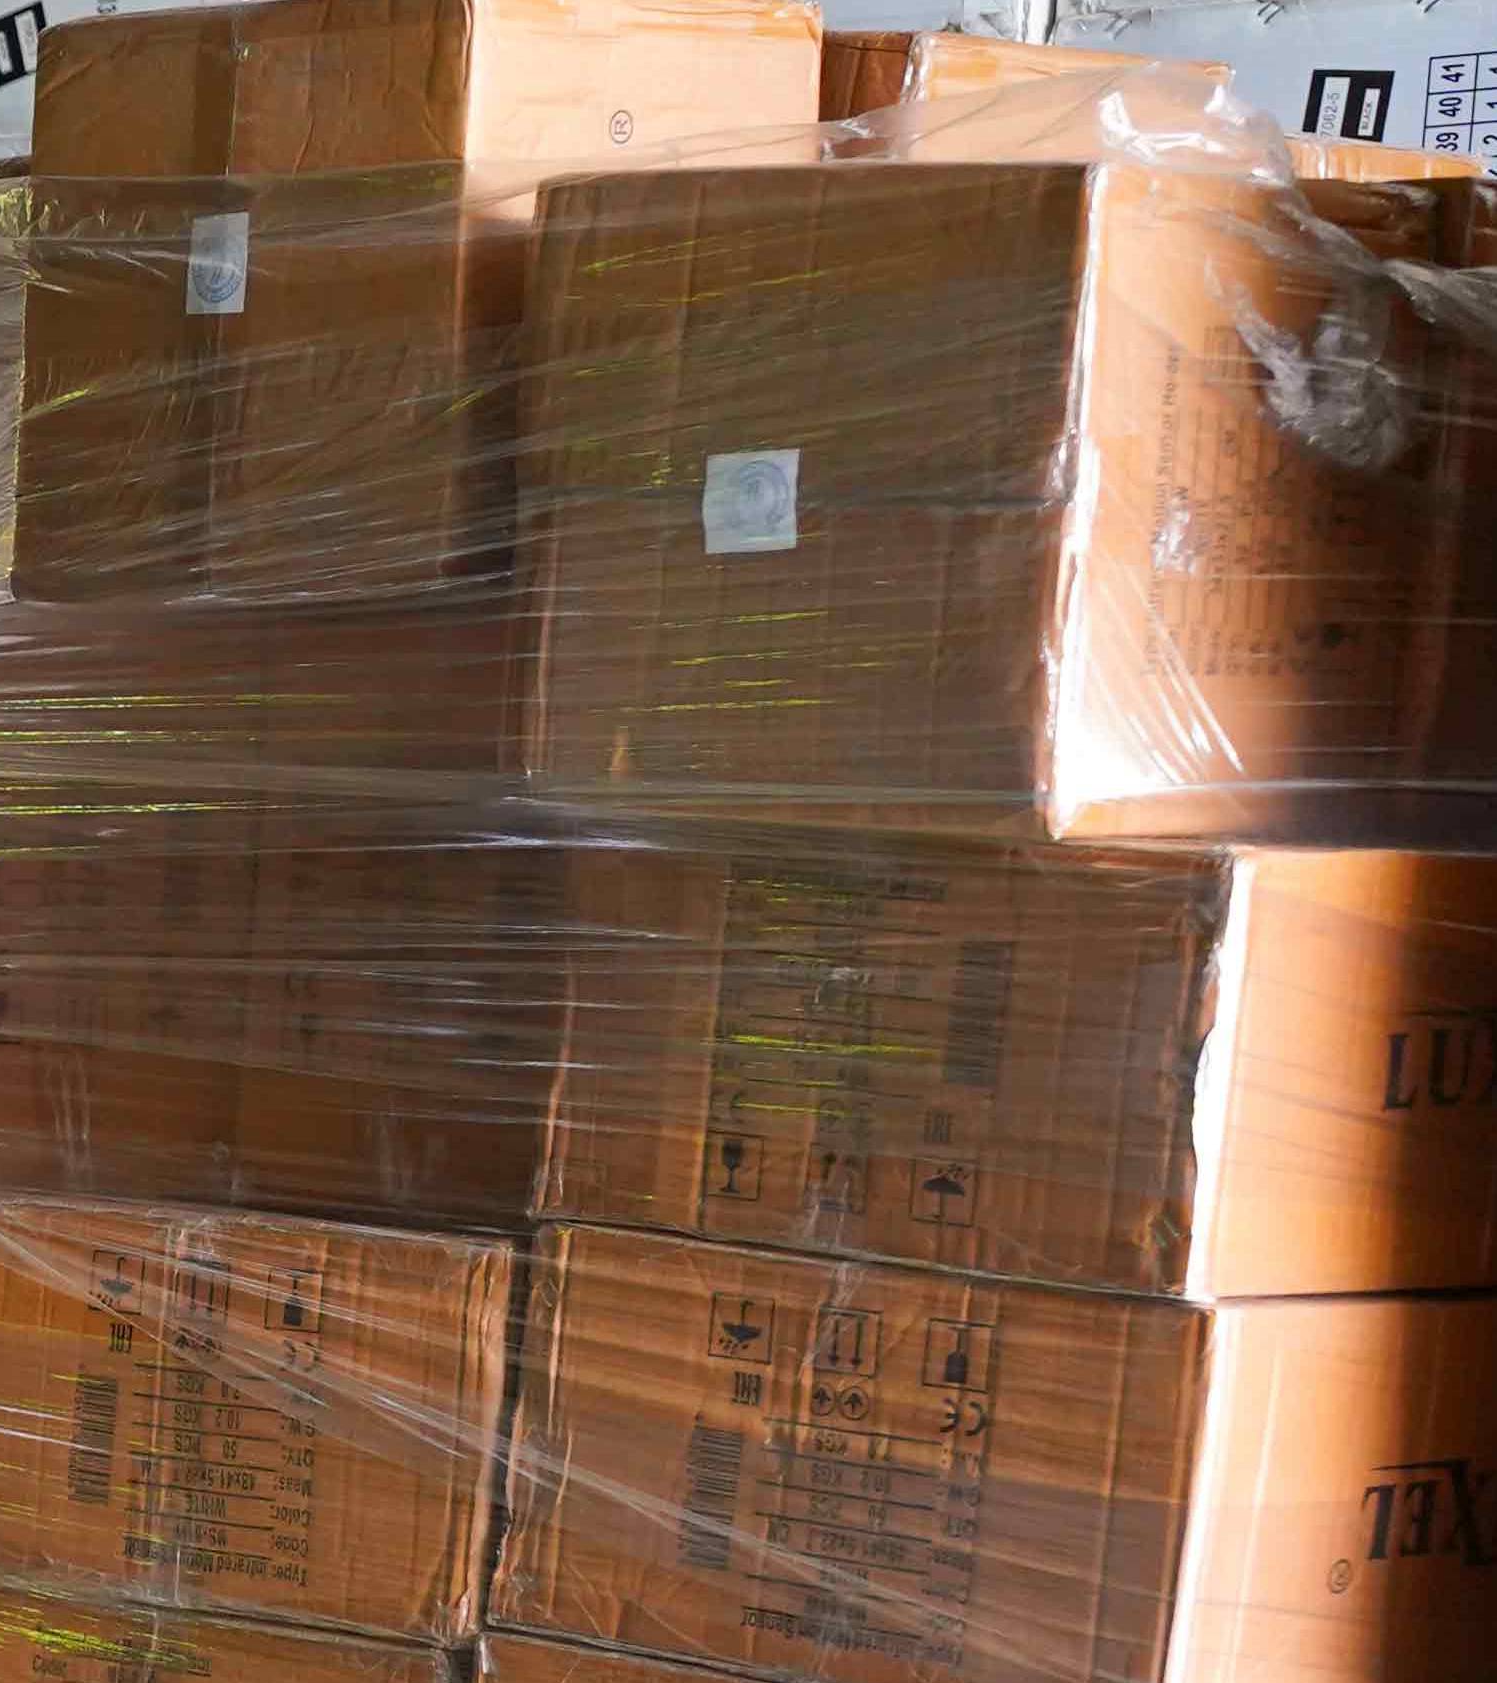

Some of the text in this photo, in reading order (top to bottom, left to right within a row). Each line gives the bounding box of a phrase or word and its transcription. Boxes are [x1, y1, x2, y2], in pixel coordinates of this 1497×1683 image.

[1440, 62, 1466, 83] 41
[1361, 100, 1375, 131] BLACK
[1438, 96, 1463, 118] 40
[171, 1433, 203, 1459] PCS
[281, 1445, 316, 1469] QTY:
[273, 1476, 314, 1502] Meas:
[186, 1493, 315, 1531] WHITE Color:
[271, 1534, 310, 1560] Code:
[216, 1554, 309, 1590] Infrared Type:
